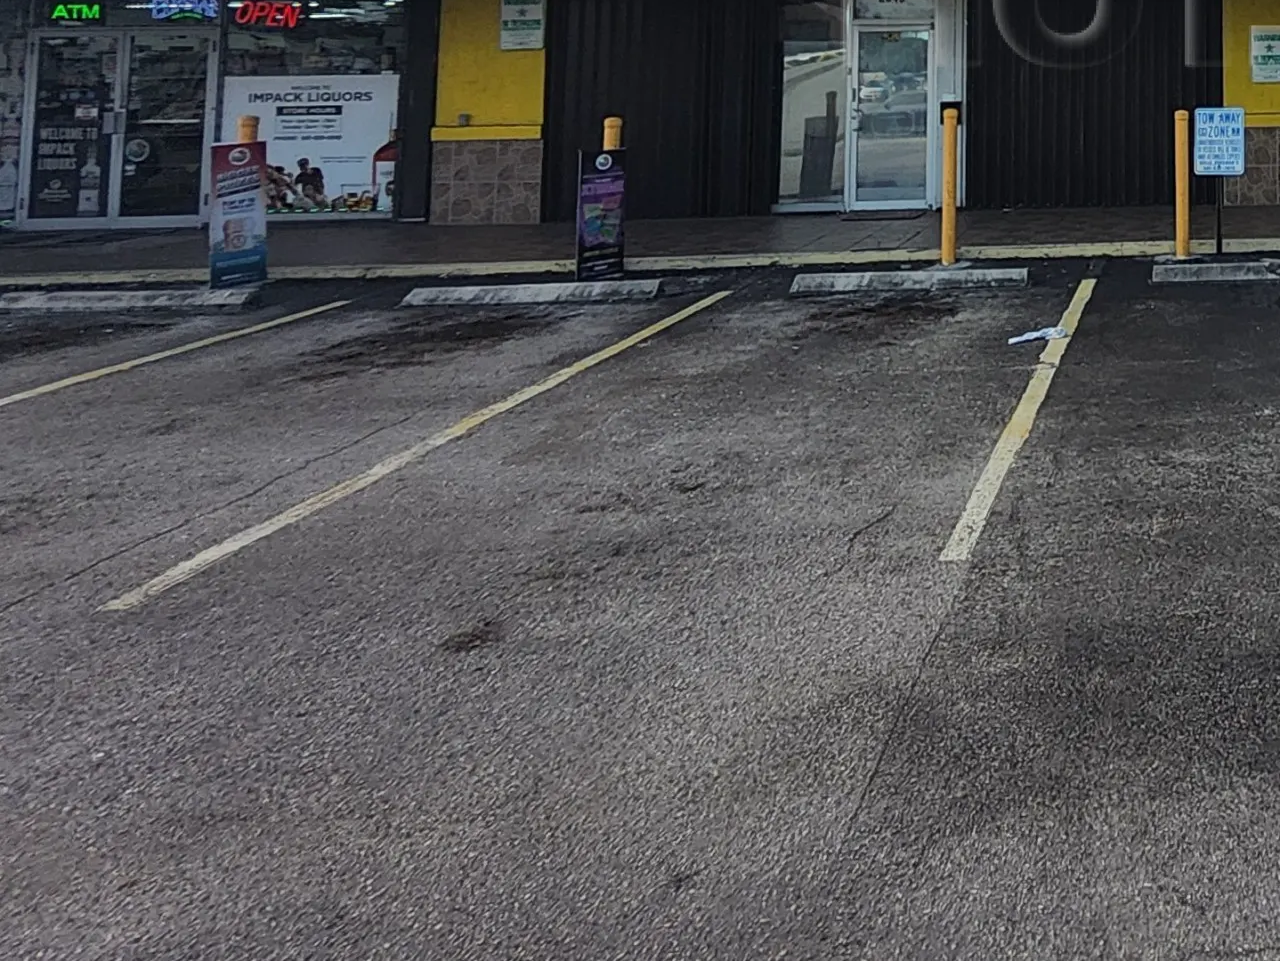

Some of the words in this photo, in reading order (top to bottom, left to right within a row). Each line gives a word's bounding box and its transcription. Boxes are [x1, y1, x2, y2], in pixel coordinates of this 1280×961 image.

[51, 4, 100, 20] ATM
[235, 0, 301, 28] OPEN
[248, 92, 304, 104] IMPACK
[307, 91, 373, 103] LIQUORS
[1197, 112, 1215, 125] TOW
[1218, 112, 1241, 125] AWAY
[1208, 125, 1230, 138] ZONE
